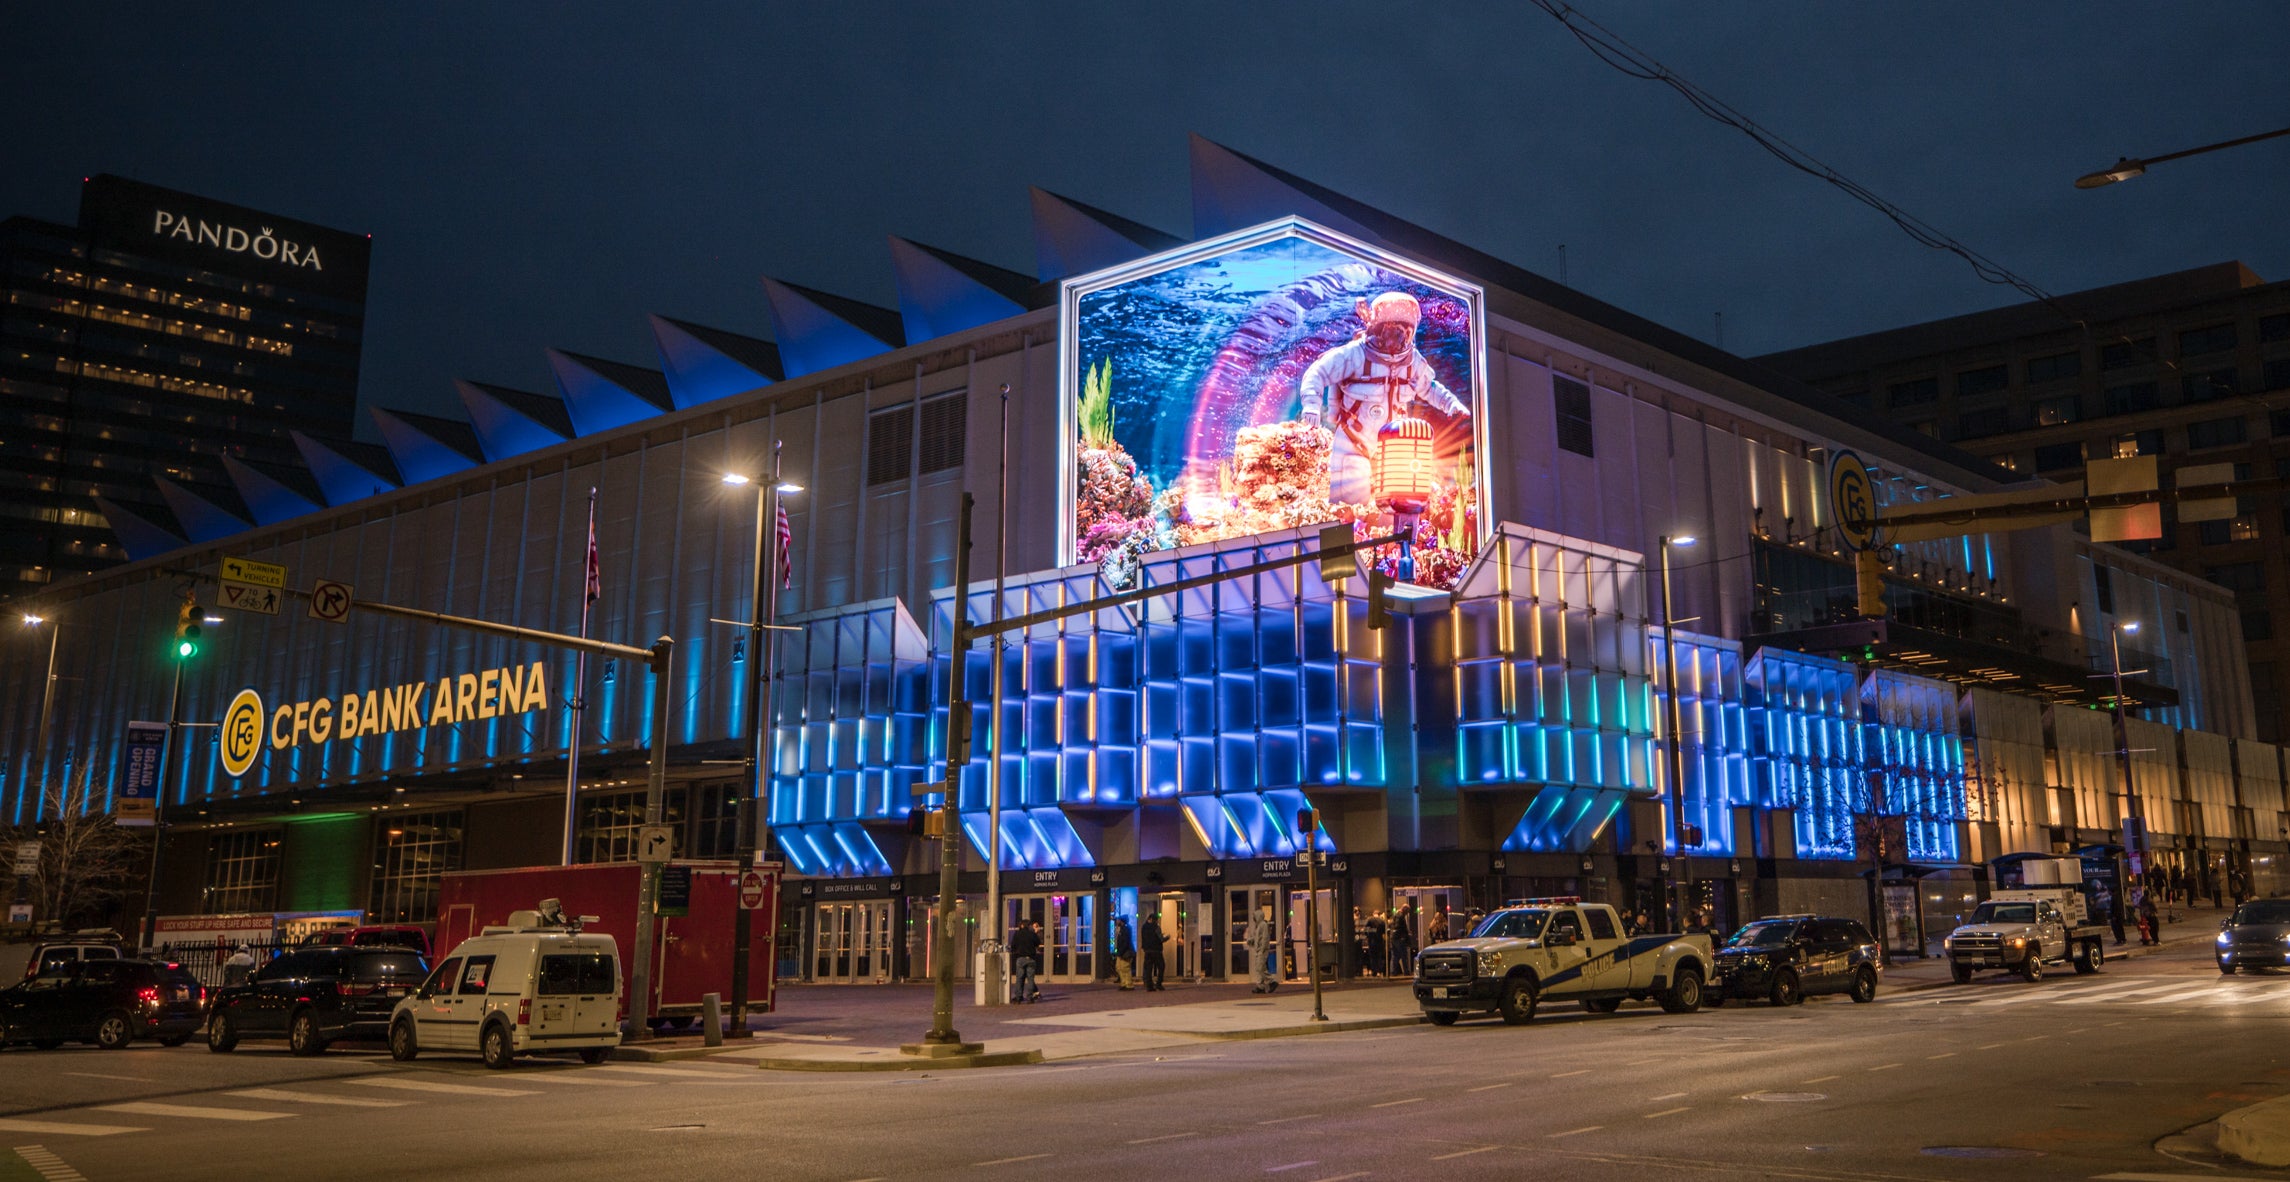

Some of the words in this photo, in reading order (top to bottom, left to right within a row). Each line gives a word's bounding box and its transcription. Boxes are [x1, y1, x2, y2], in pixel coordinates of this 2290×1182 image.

[154, 210, 322, 271] PANDORA
[247, 563, 281, 575] TURNING
[244, 573, 280, 584] VEHICLES
[249, 588, 258, 597] TO
[271, 698, 333, 750] CFG
[339, 681, 426, 740] BANK
[430, 661, 548, 727] ARENA
[127, 747, 143, 796] OPENING
[141, 748, 156, 787] GRAND
[1263, 860, 1290, 871] ENTRY
[1035, 871, 1057, 881] ENTRY
[825, 885, 834, 893] BOX
[835, 884, 849, 892] OFFICE
[866, 883, 878, 891] CALL
[163, 922, 175, 930] LOCK
[177, 921, 189, 929] YOUR
[190, 920, 205, 929] STUFF
[205, 920, 212, 928] UP
[213, 919, 226, 928] HERE
[227, 919, 240, 928] SAFE
[240, 919, 251, 928] AND
[252, 918, 273, 927] SECURE
[1581, 952, 1615, 983] POLICE
